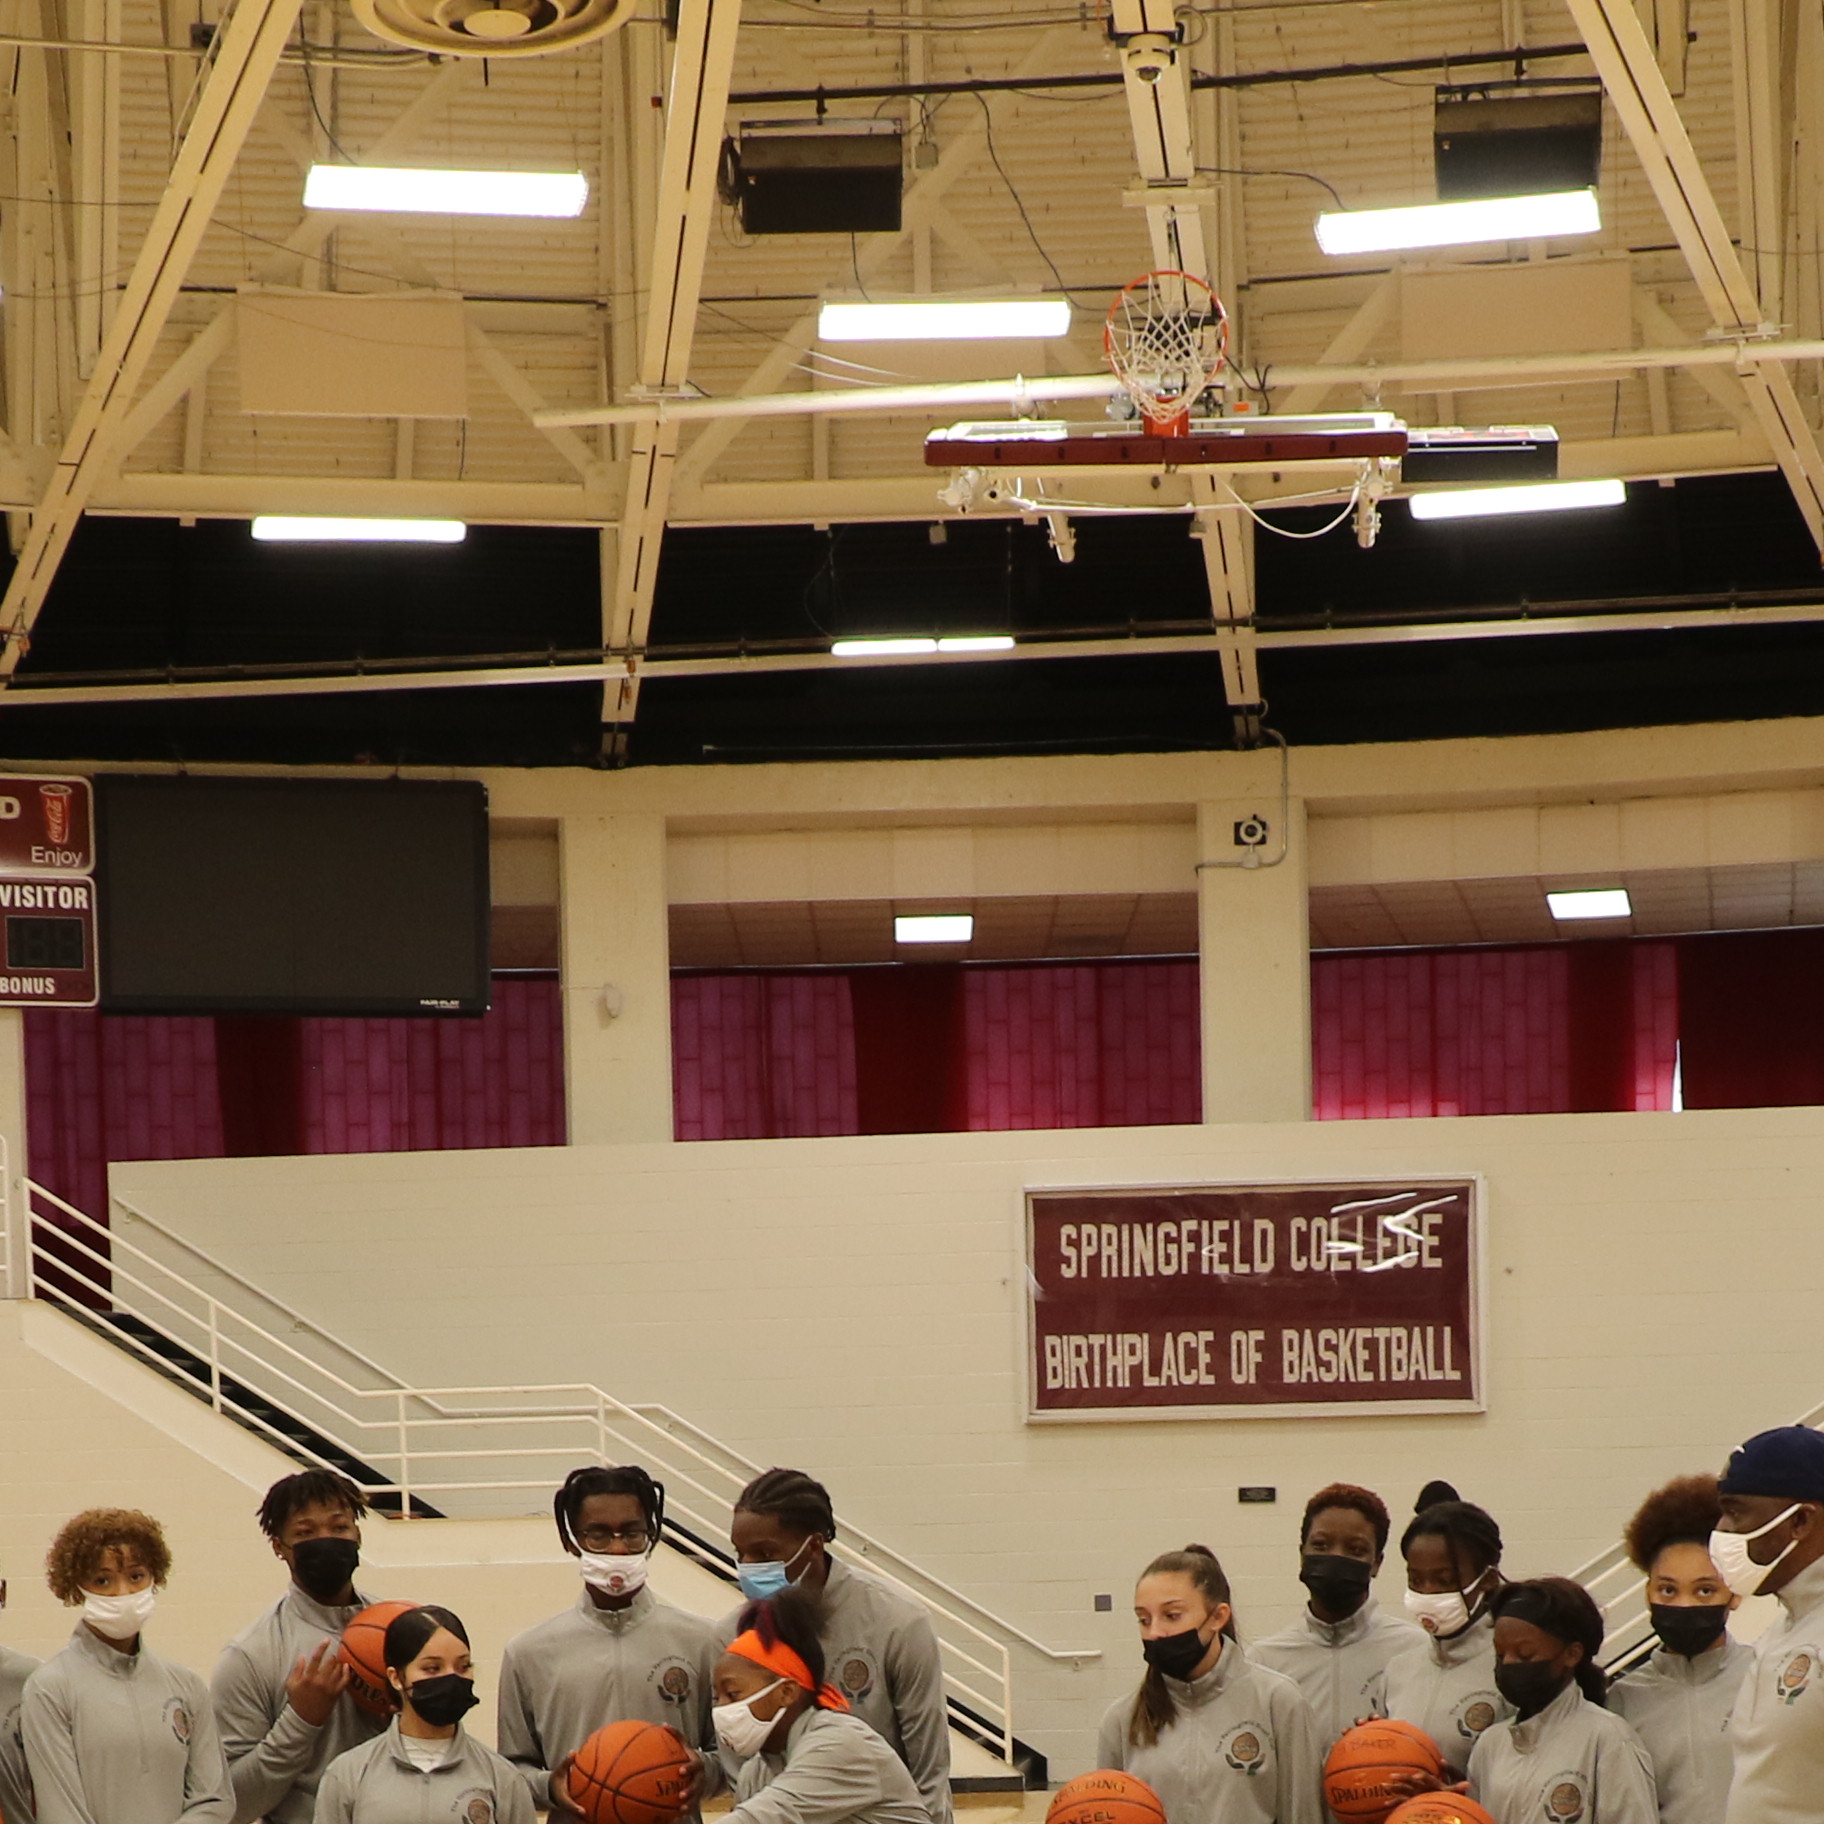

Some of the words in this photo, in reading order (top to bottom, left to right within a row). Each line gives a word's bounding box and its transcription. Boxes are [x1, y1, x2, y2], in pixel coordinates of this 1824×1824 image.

[31, 846, 83, 867] Enjoy
[1059, 1217, 1275, 1279] SPRINGFIELD
[1044, 1330, 1215, 1390] BIRTHPLACE
[1230, 1330, 1265, 1385] OF
[1282, 1325, 1461, 1384] BASKETBALL
